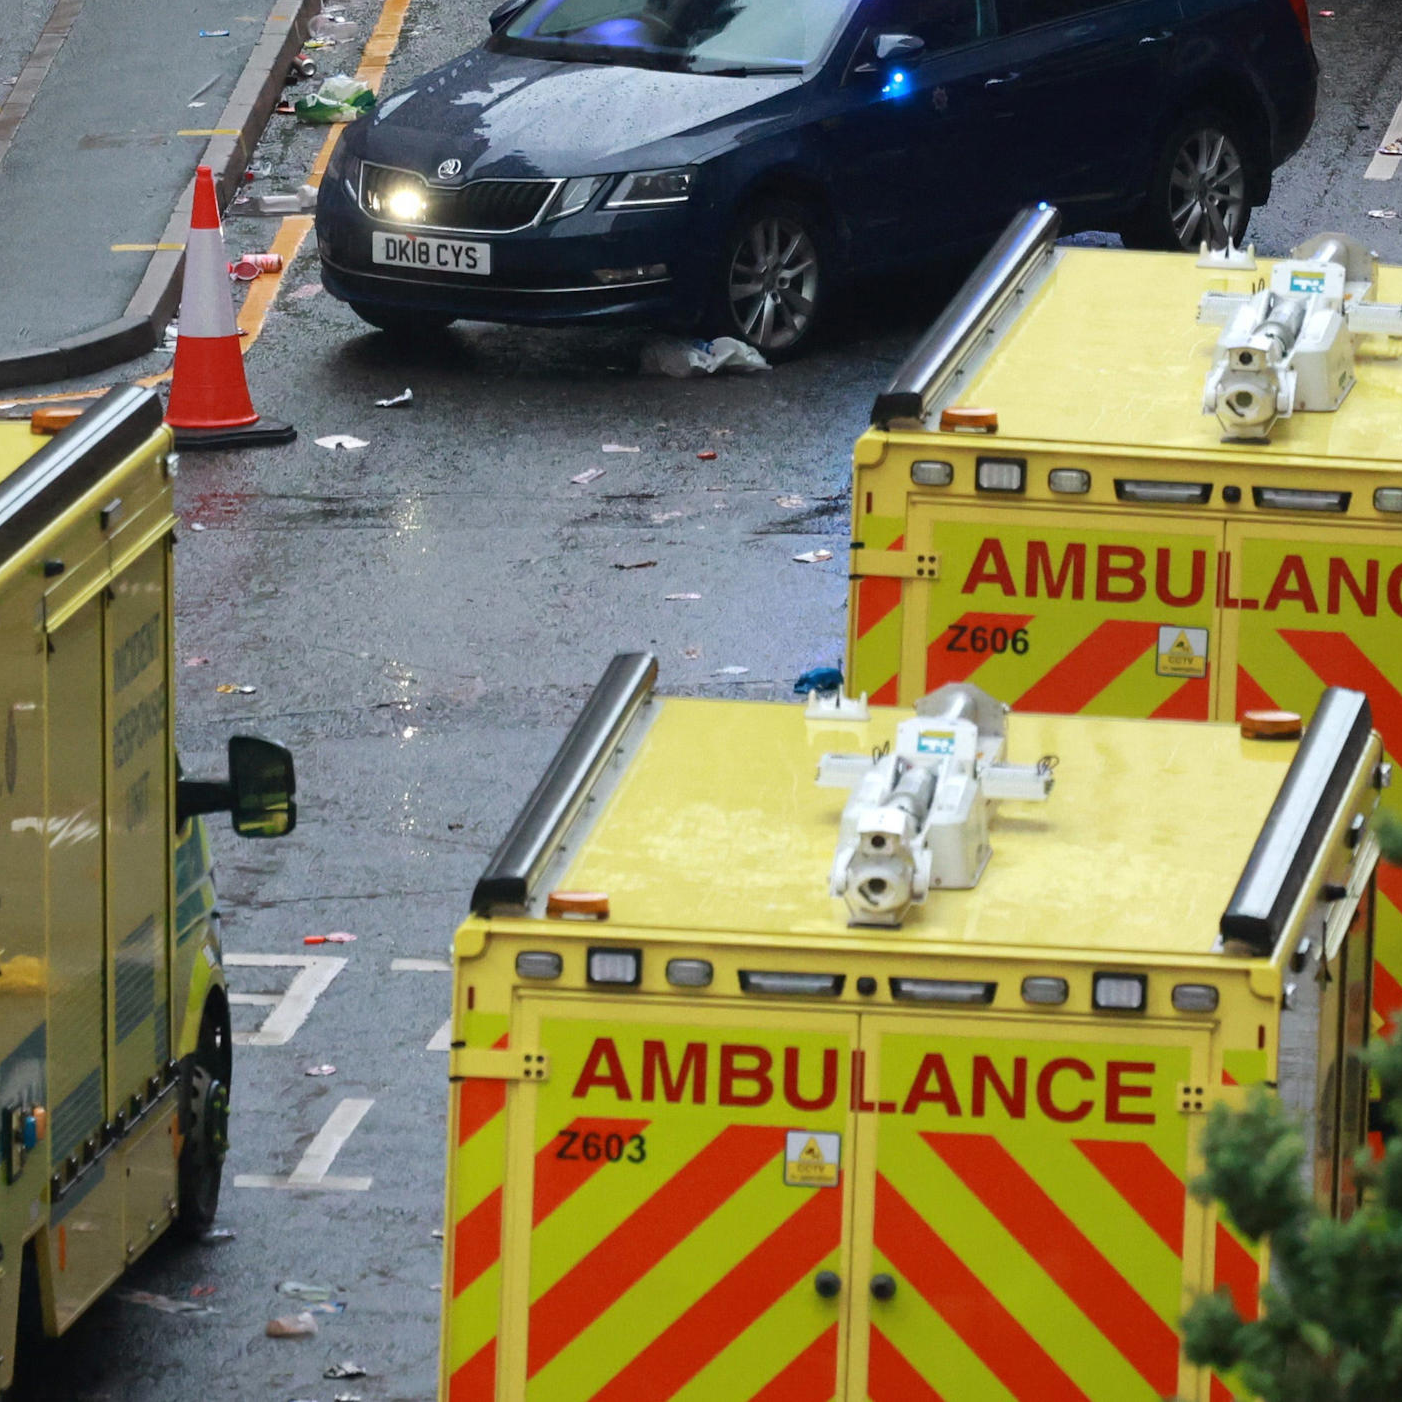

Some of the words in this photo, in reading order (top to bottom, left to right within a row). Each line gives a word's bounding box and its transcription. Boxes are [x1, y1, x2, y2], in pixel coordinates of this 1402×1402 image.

[385, 237, 430, 264] DK18
[436, 243, 478, 269] CYS
[946, 623, 1030, 657] Z606
[571, 1036, 1157, 1125] AMBULANCE
[556, 1129, 647, 1165] Z603
